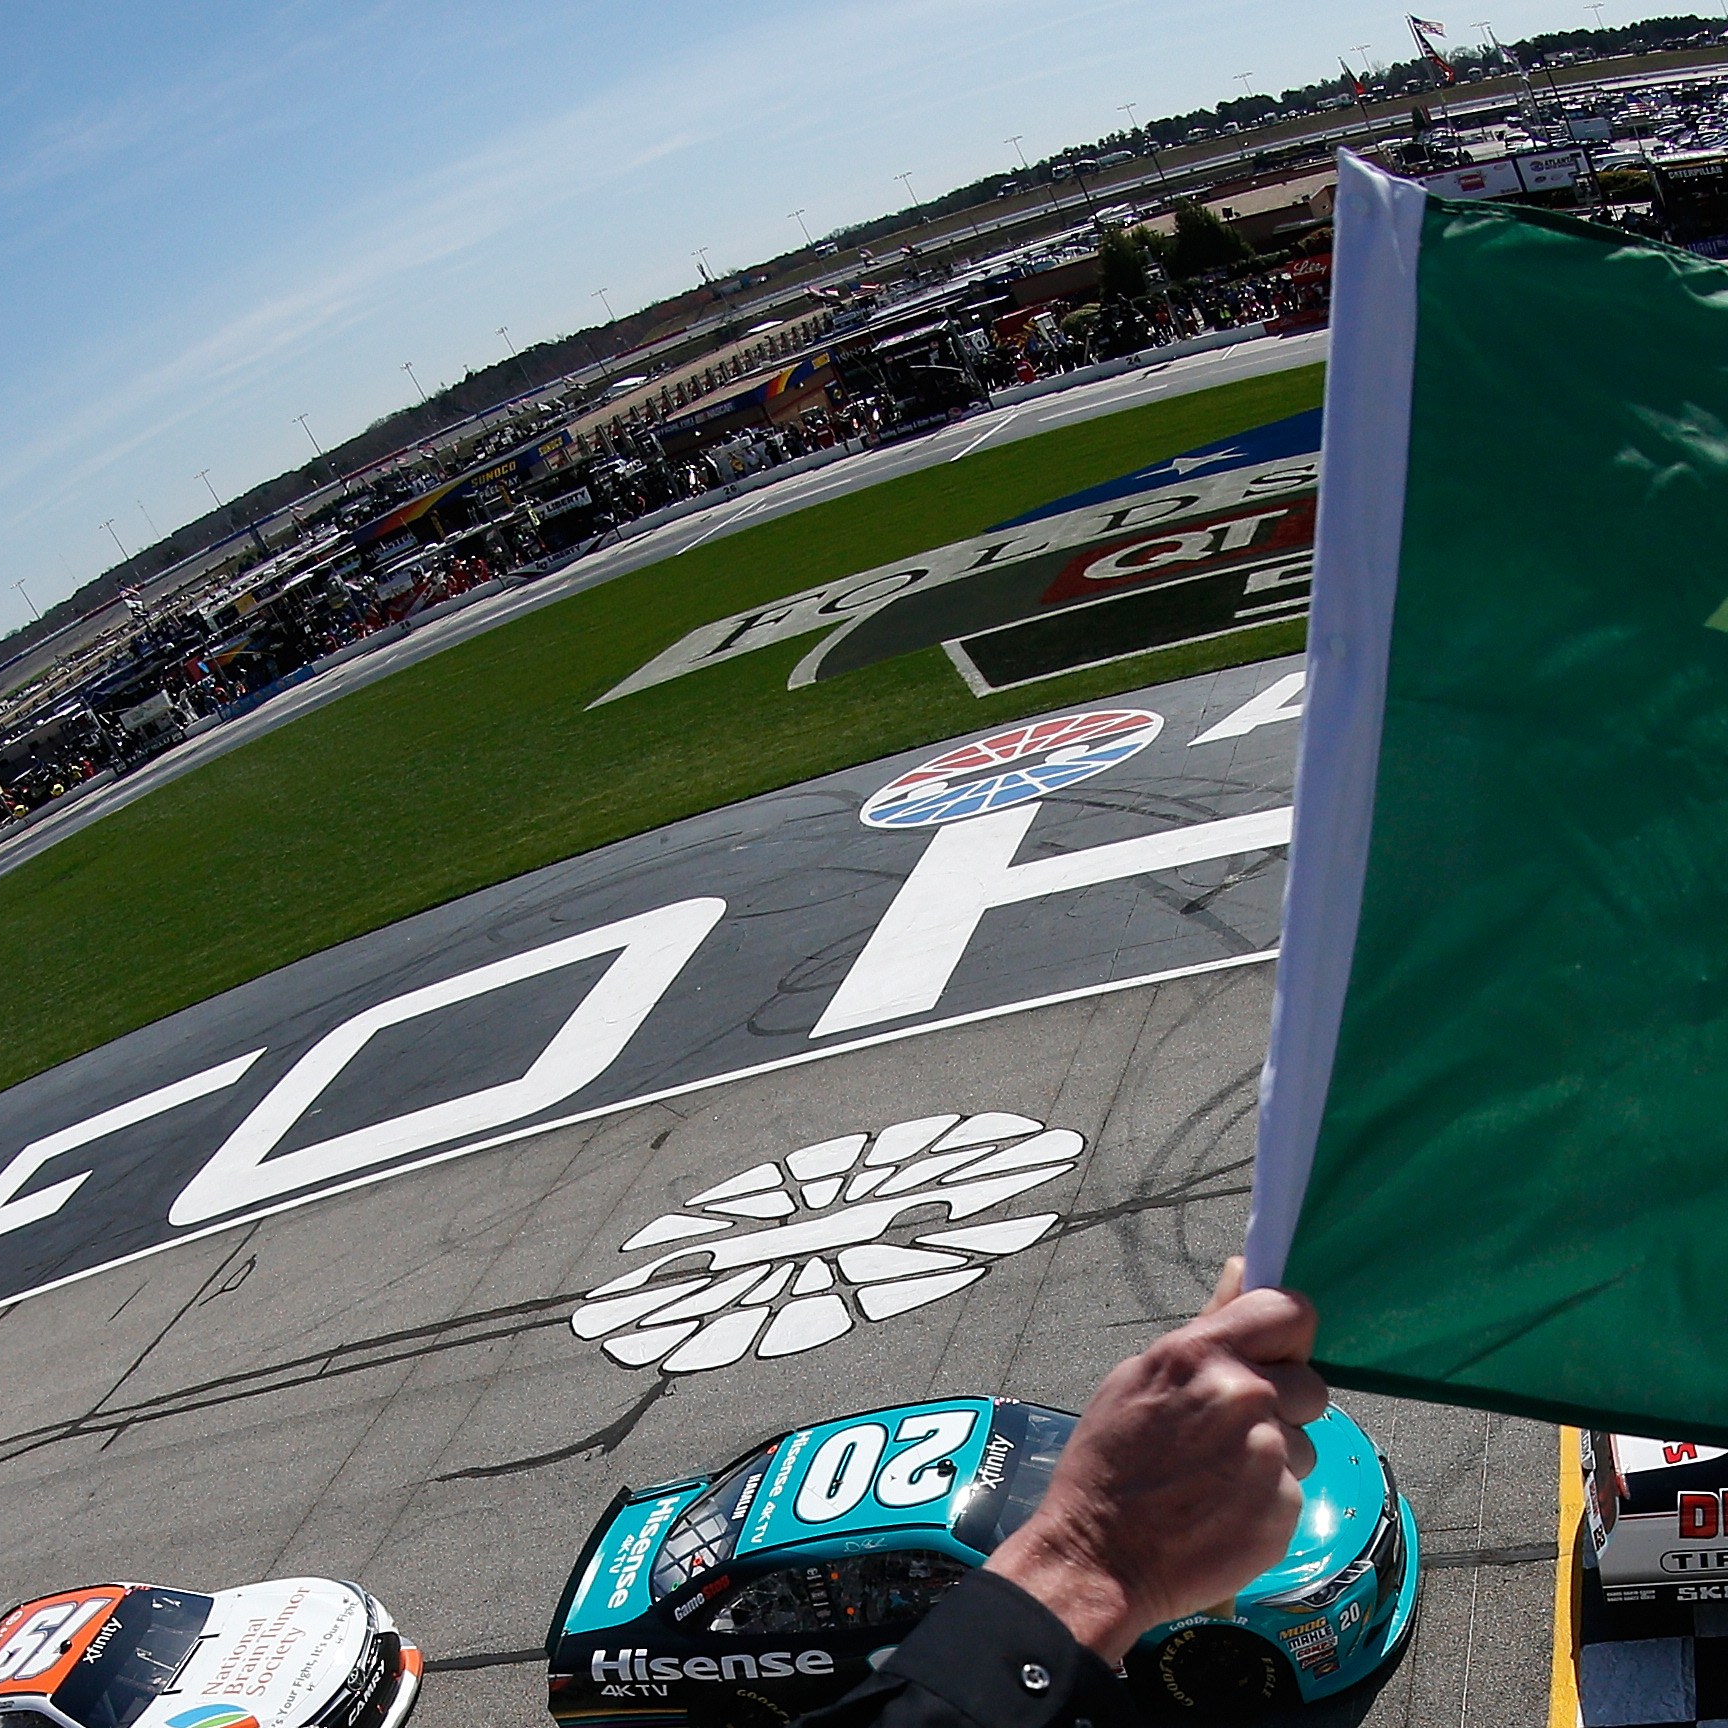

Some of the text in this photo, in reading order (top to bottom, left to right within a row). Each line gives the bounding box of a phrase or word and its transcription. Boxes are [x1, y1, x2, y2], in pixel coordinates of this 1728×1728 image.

[1125, 354, 1141, 366] 24
[471, 460, 517, 488] SUNOCO
[546, 486, 587, 514] LIBERTY
[548, 543, 582, 563] LIBERTY
[767, 1428, 814, 1498] Hisense
[792, 1409, 980, 1524] 20
[730, 1472, 764, 1521] HAMLIN
[607, 1495, 681, 1610] Hisense
[1279, 1616, 1328, 1641] MOOG
[1339, 1602, 1361, 1632] 20
[223, 1586, 311, 1696] Brain Tumor
[1286, 1625, 1334, 1650] MAHLE
[201, 1617, 268, 1697] National
[245, 1625, 307, 1697] Society
[590, 1648, 835, 1683] Hisense
[348, 1660, 386, 1726] CAMRY
[638, 1684, 669, 1697] TV
